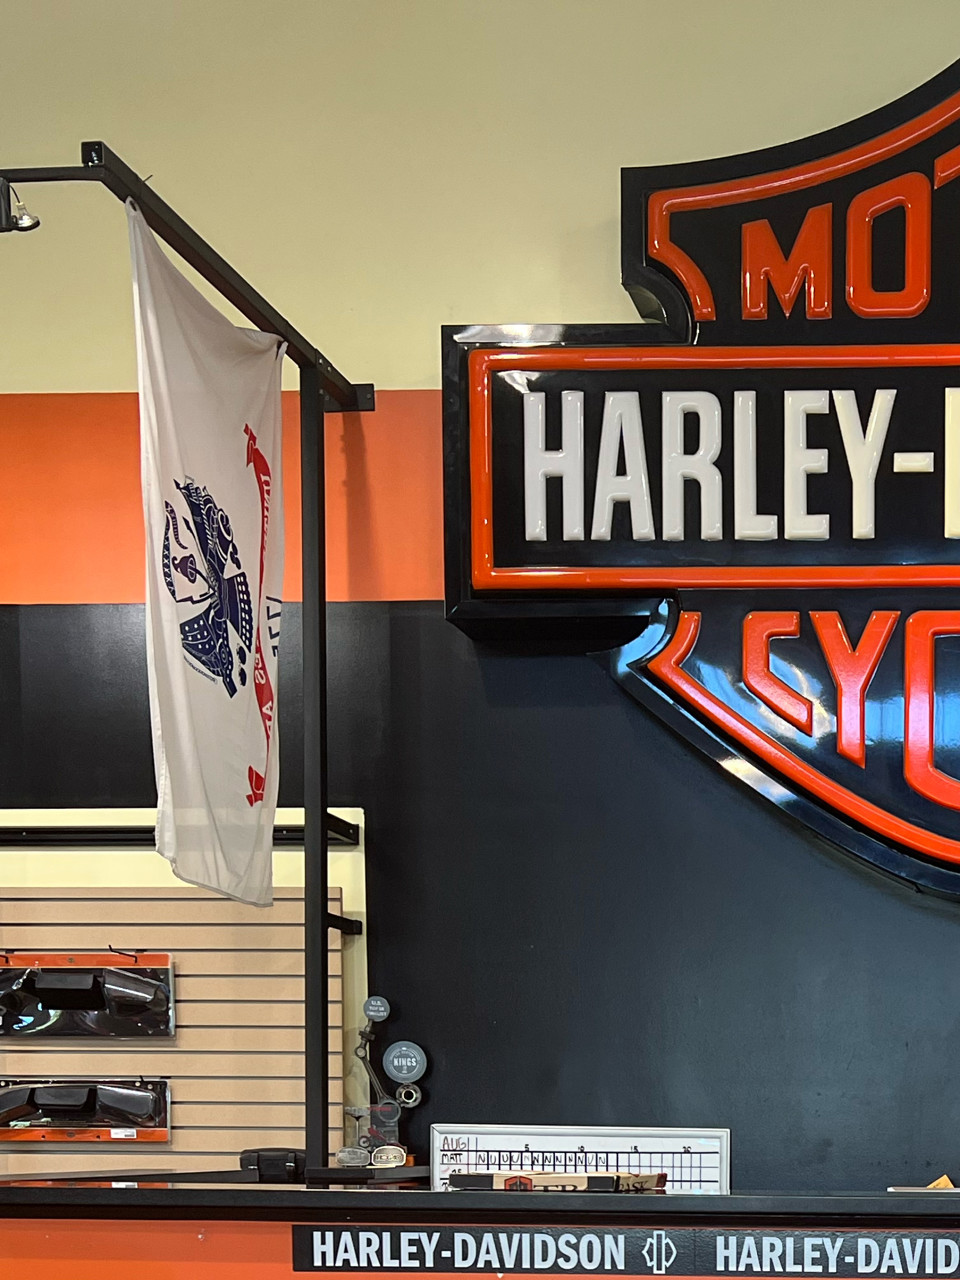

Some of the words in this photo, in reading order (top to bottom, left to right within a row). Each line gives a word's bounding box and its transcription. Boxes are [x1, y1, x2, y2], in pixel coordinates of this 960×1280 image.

[393, 1057, 417, 1067] KINGS
[442, 1136, 467, 1150] AUG
[311, 1230, 625, 1271] HARLEY-DAVIDSON
